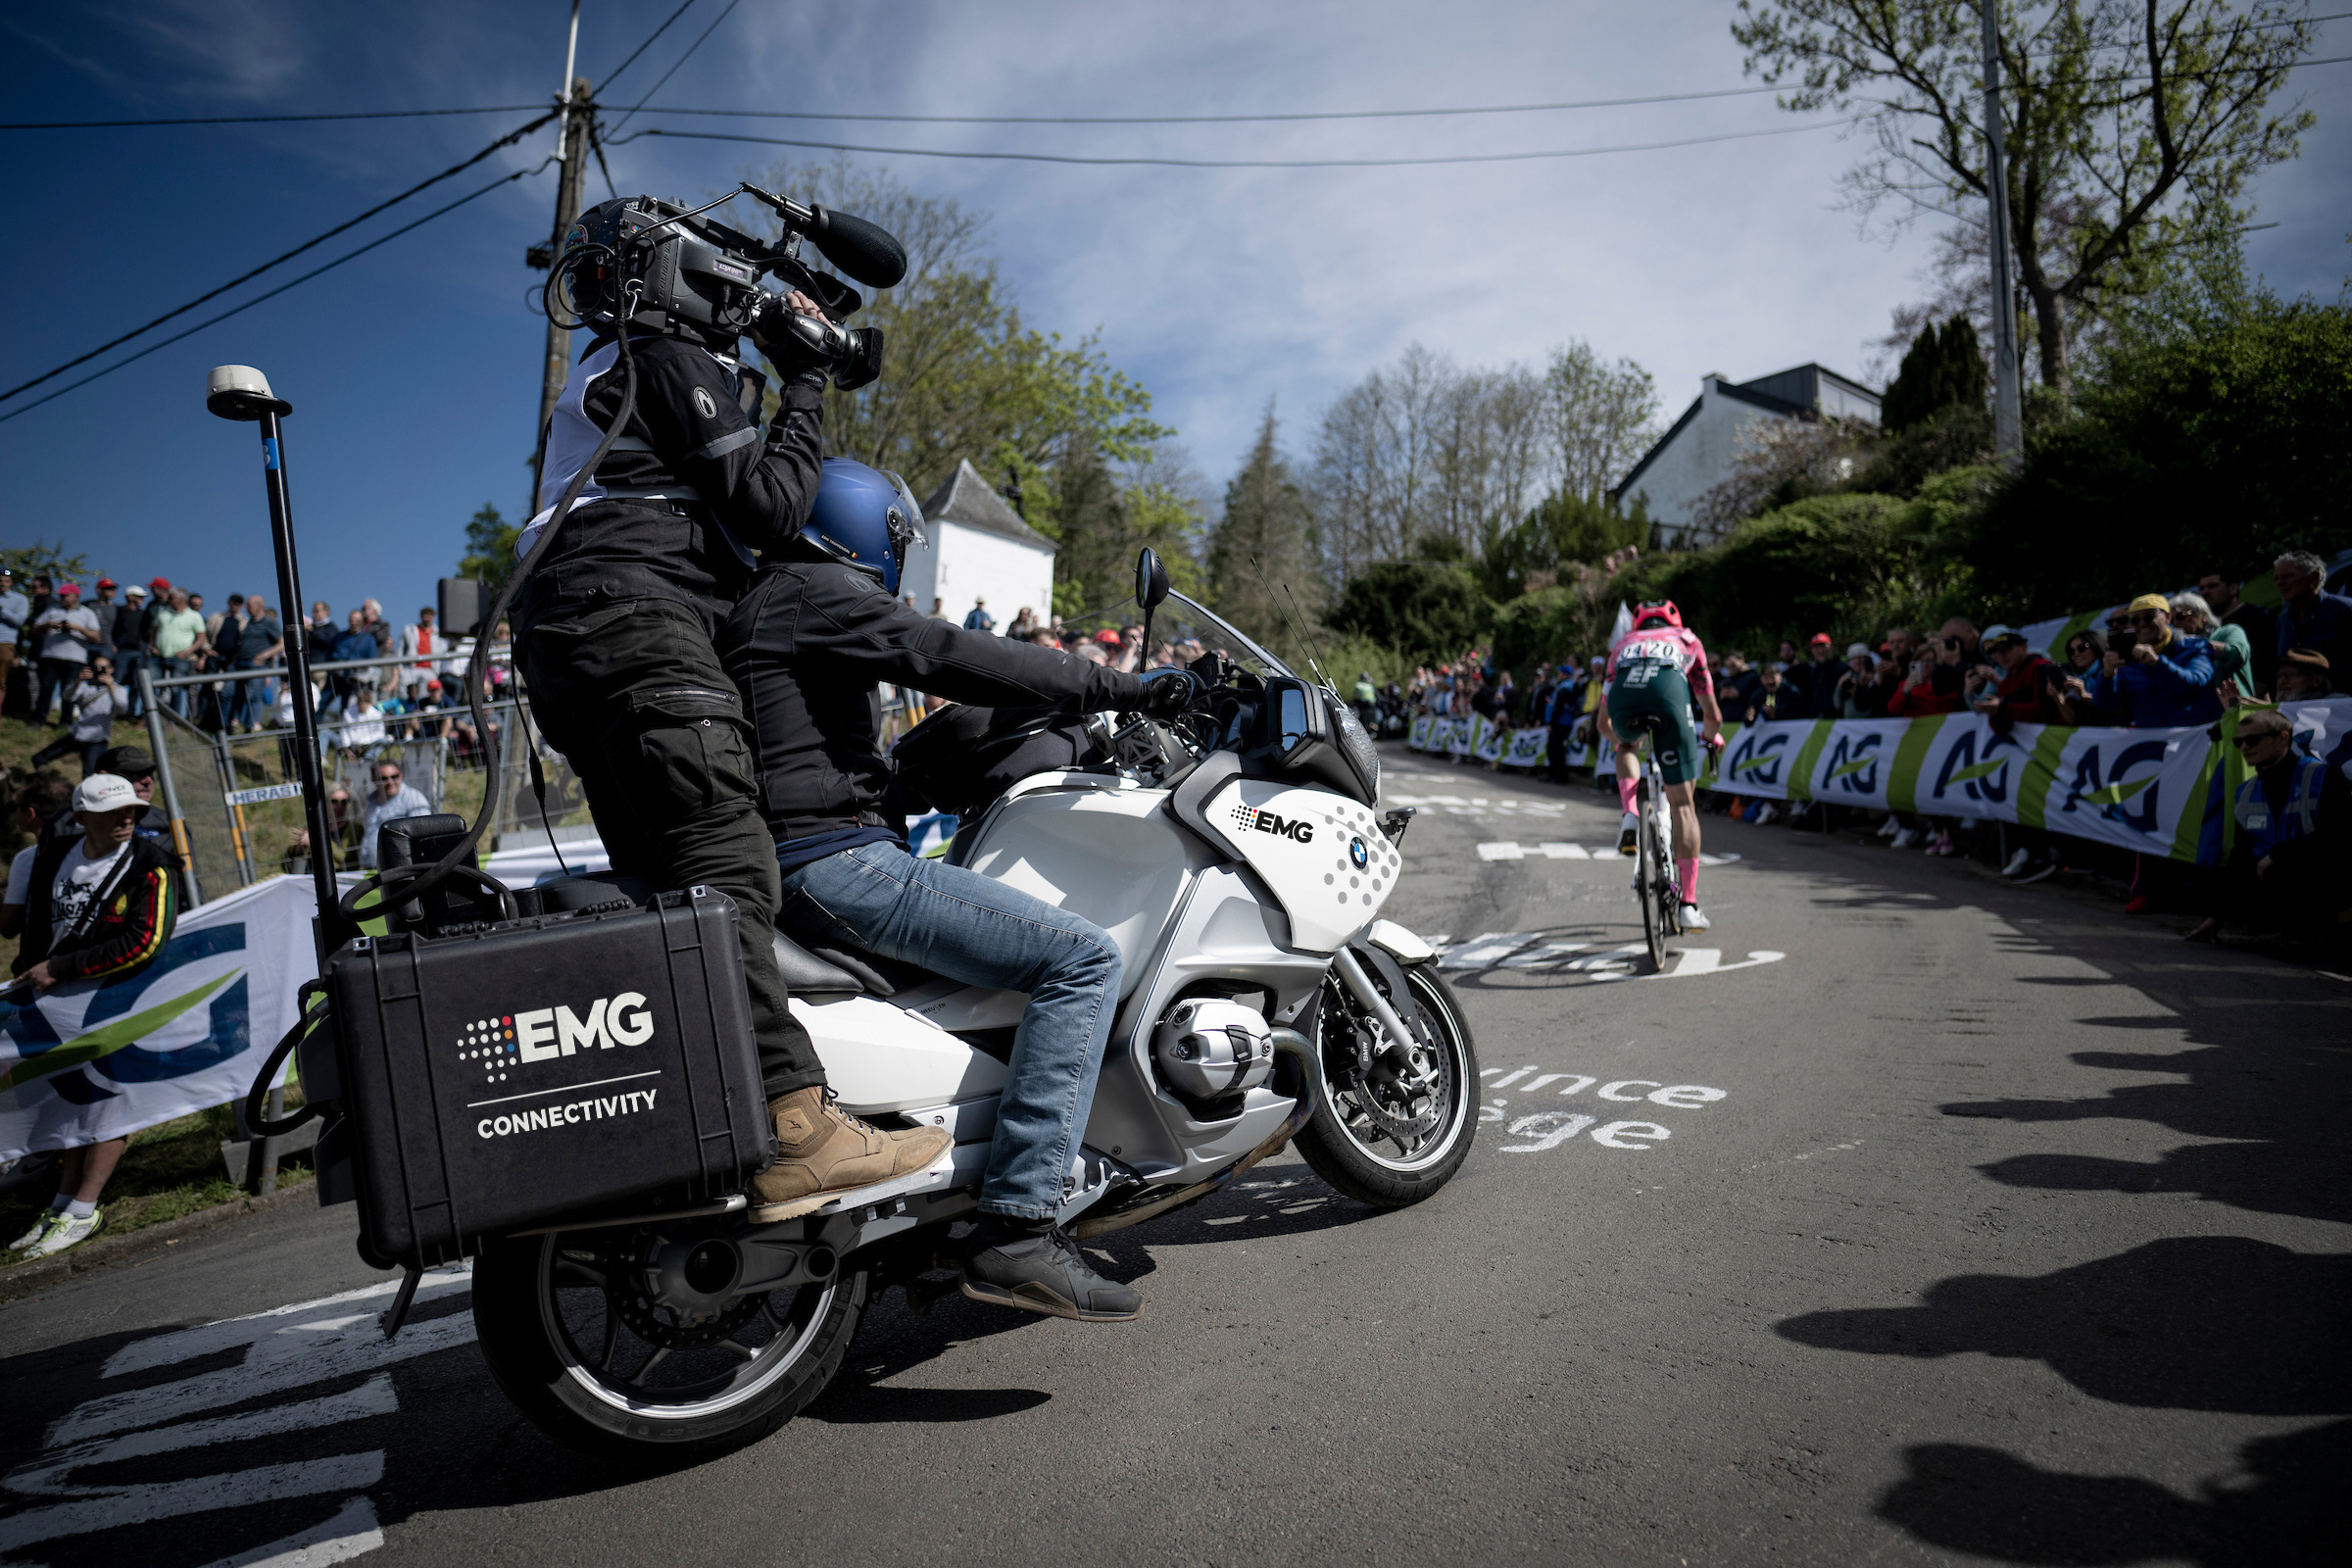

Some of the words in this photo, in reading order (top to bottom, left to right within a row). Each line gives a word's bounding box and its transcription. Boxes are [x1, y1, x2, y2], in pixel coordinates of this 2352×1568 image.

[232, 786, 291, 805] HERAS
[1254, 810, 1314, 843] EMG
[514, 991, 655, 1064] EMG
[477, 1089, 658, 1139] CONNECTIVITY
